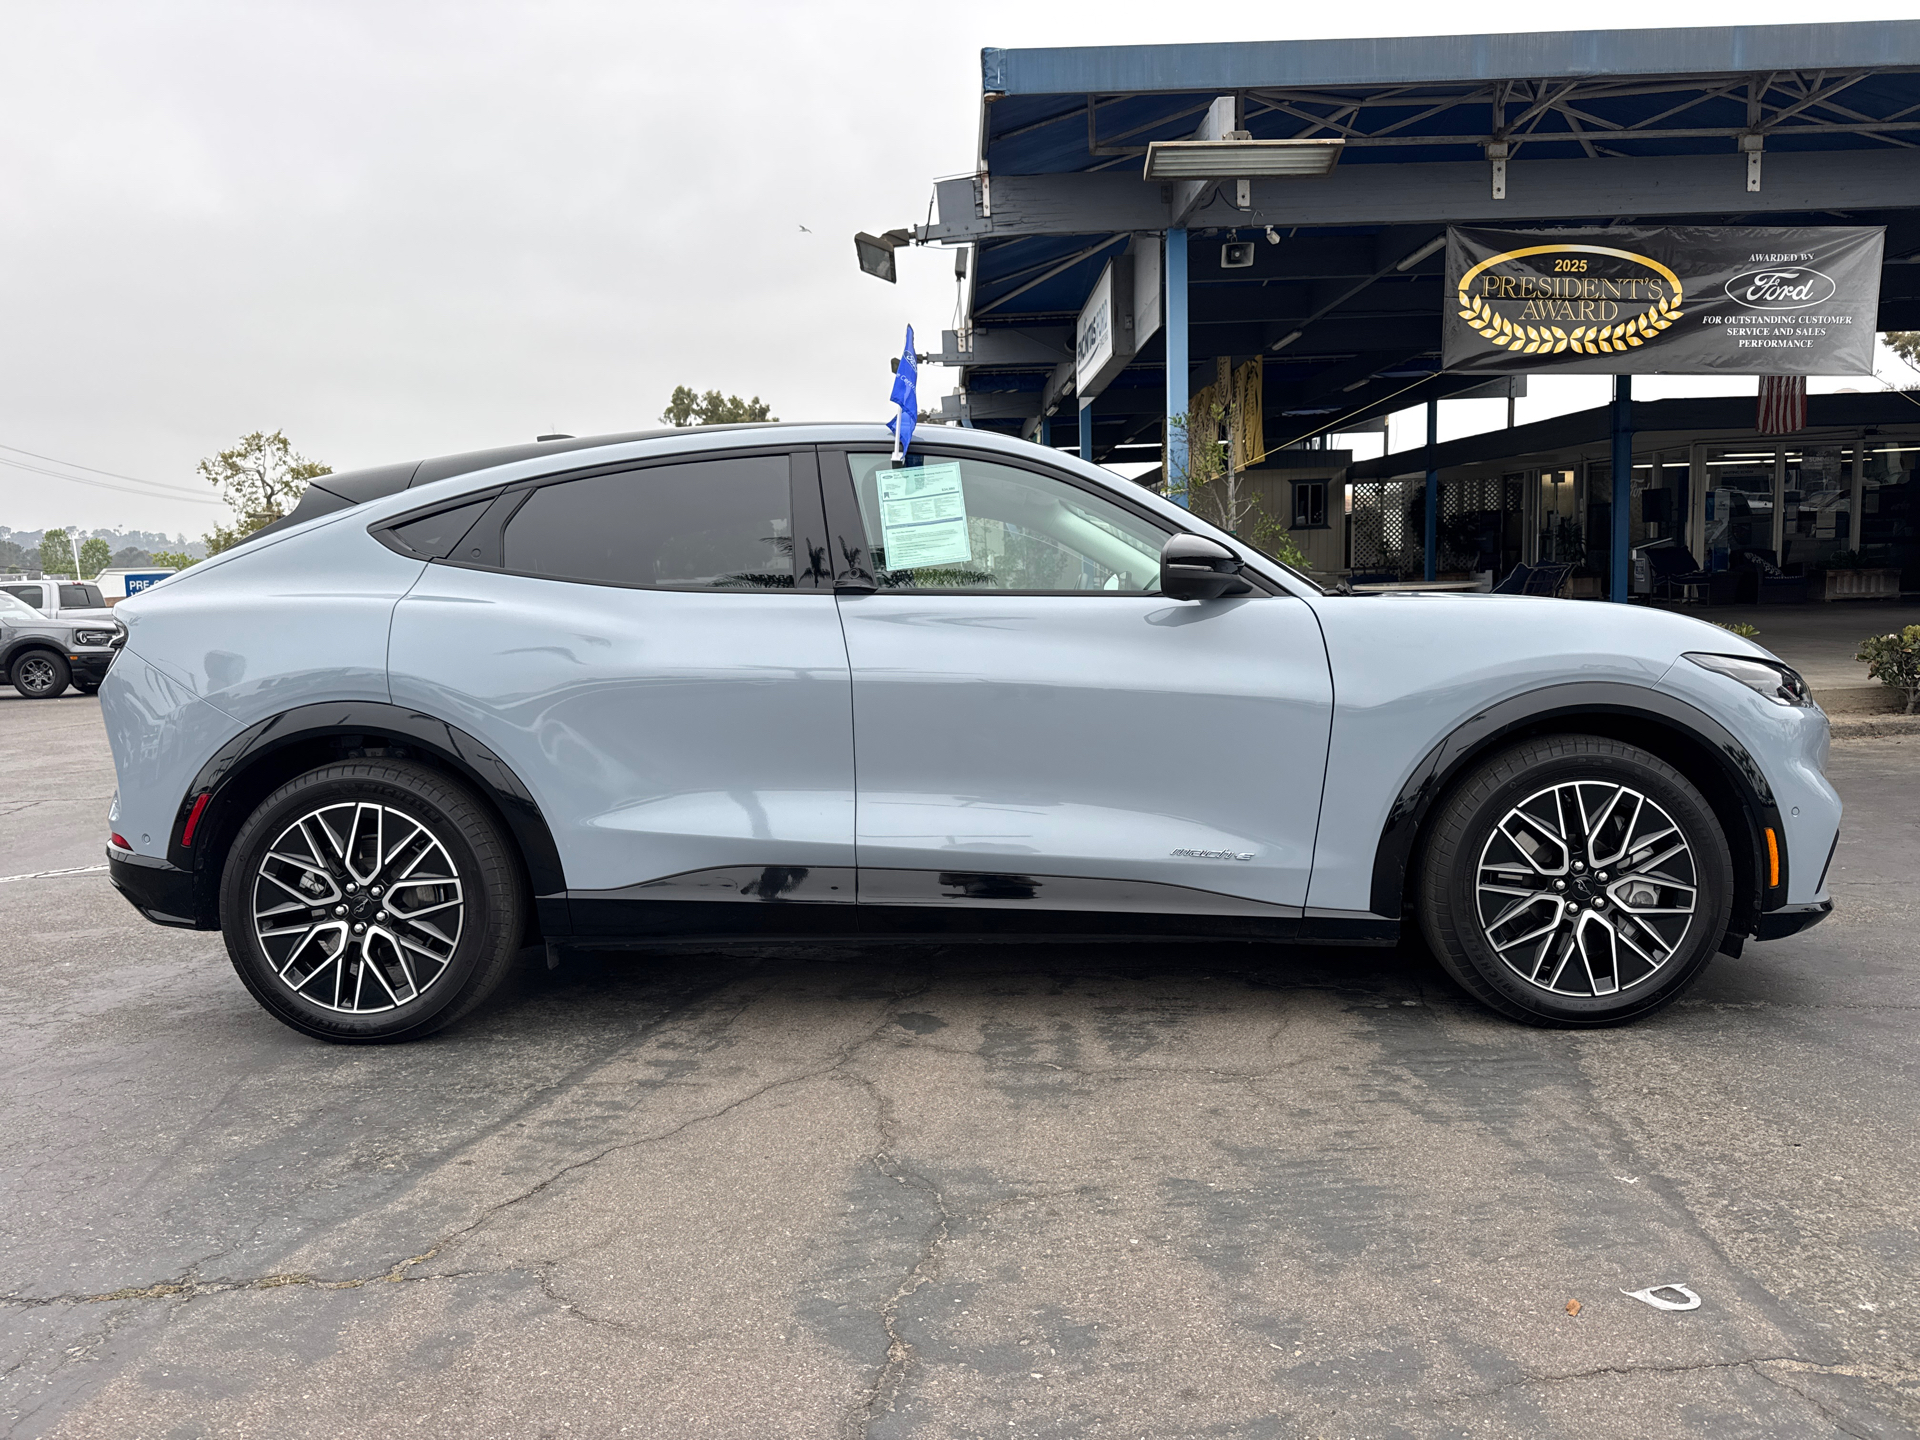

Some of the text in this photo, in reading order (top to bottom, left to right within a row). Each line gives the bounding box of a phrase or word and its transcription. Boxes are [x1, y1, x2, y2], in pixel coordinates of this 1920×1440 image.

[1748, 253, 1815, 262] AWARDED BY
[1554, 259, 1588, 272] 2025
[1481, 275, 1663, 300] PRESIDENT'S
[1746, 272, 1814, 301] Ford
[1518, 299, 1619, 321] AWARD
[1702, 315, 1853, 324] FOR OUTSTANDING CUSTOMER
[1726, 327, 1826, 336] SERVICE AND SALES
[1738, 339, 1814, 348] PERFORMANCE
